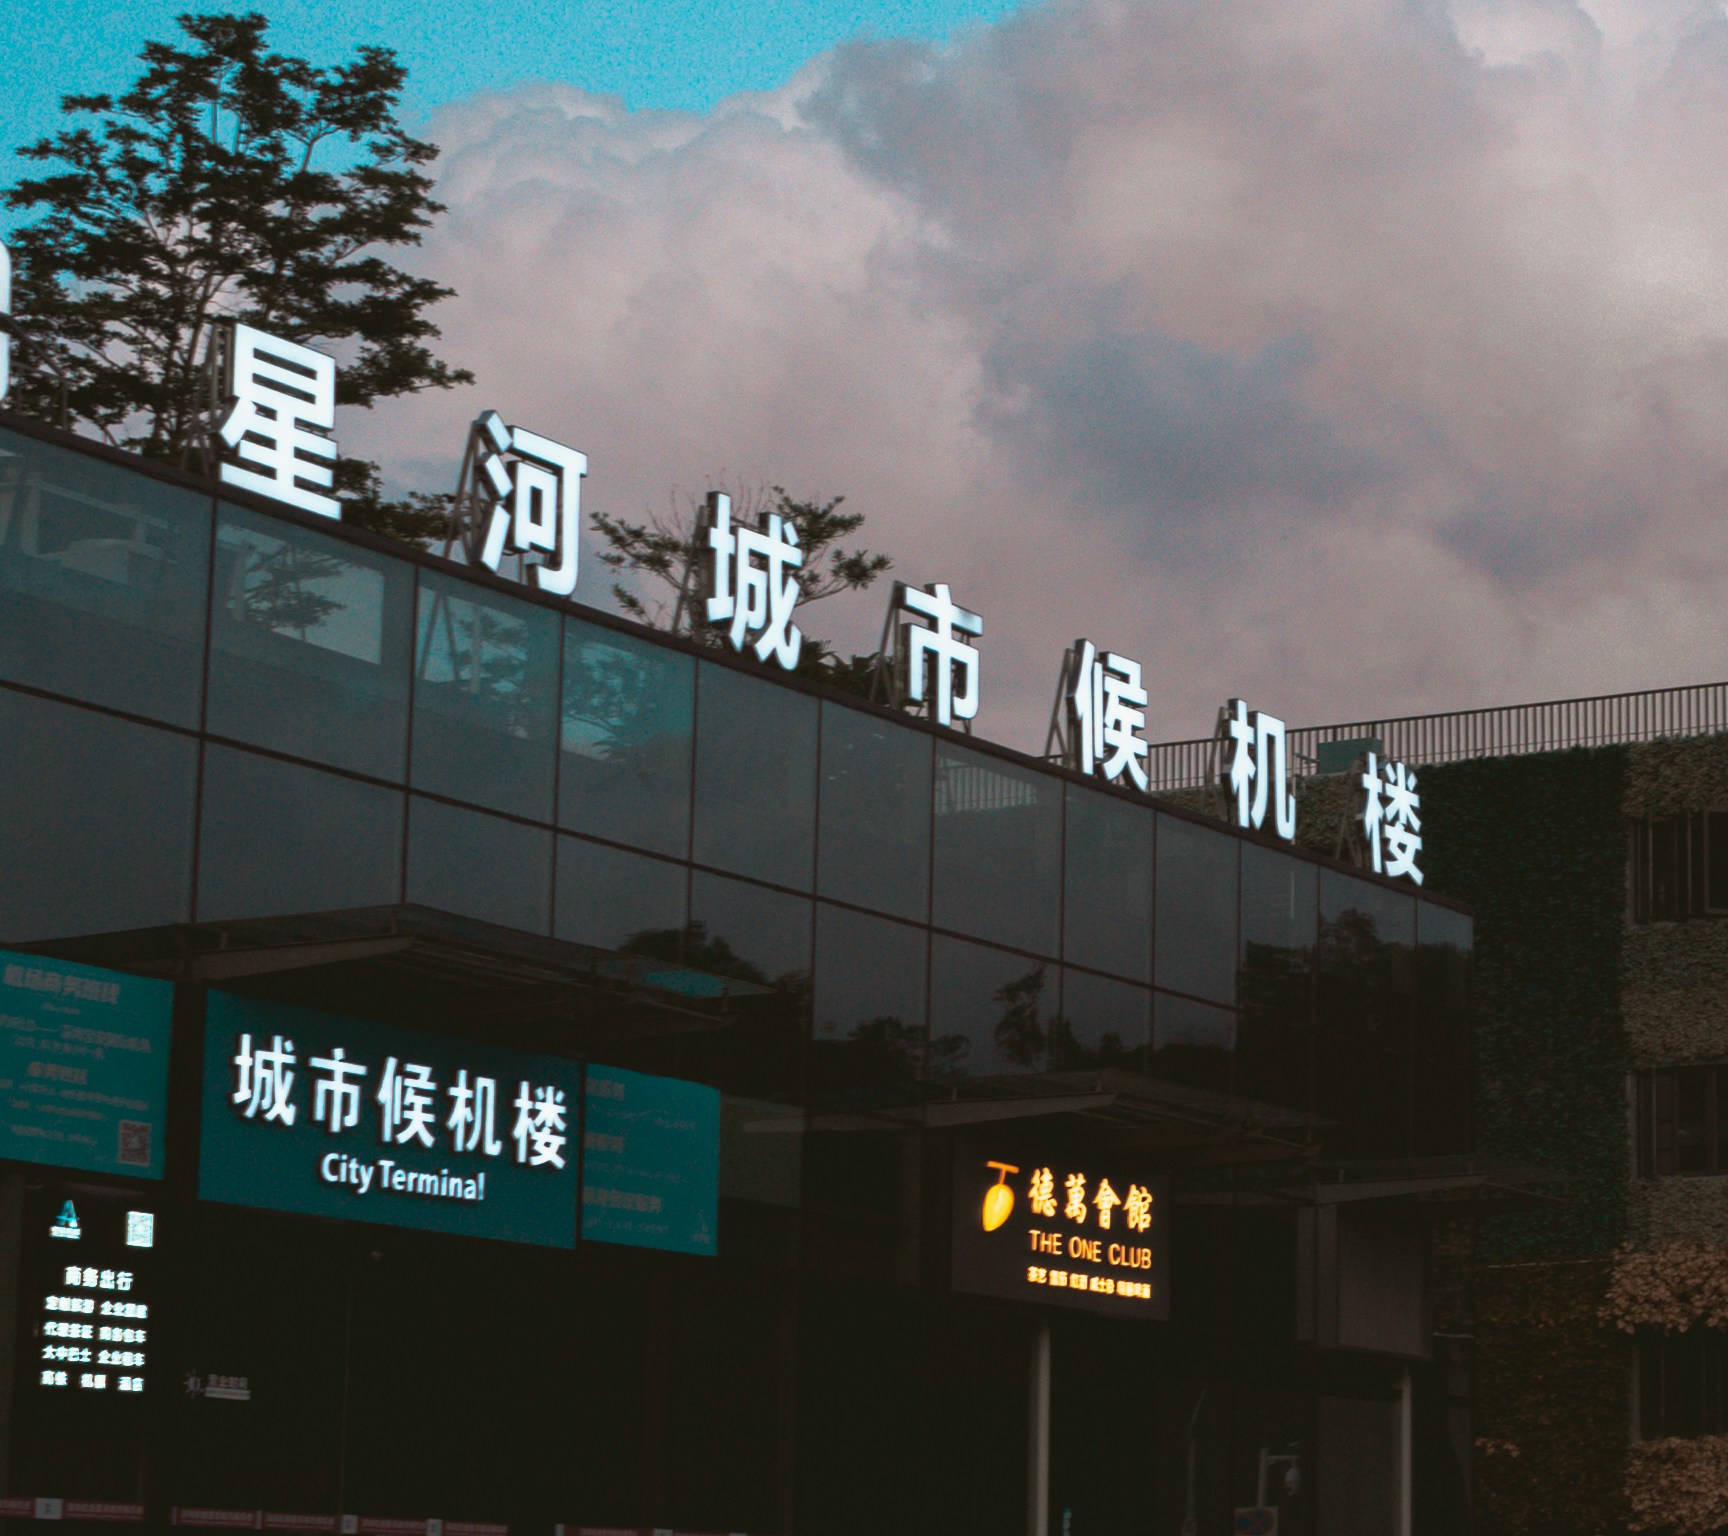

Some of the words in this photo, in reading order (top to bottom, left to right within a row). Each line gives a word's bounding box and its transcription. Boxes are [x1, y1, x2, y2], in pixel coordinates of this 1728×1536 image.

[232, 1032, 568, 1170] 城市候机楼
[321, 1152, 375, 1197] City
[379, 1160, 486, 1202] Terminal
[1028, 1230, 1063, 1255] THE
[1068, 1236, 1102, 1262] ONE
[1108, 1243, 1151, 1269] CLUB
[65, 1266, 133, 1290] 商务出行
